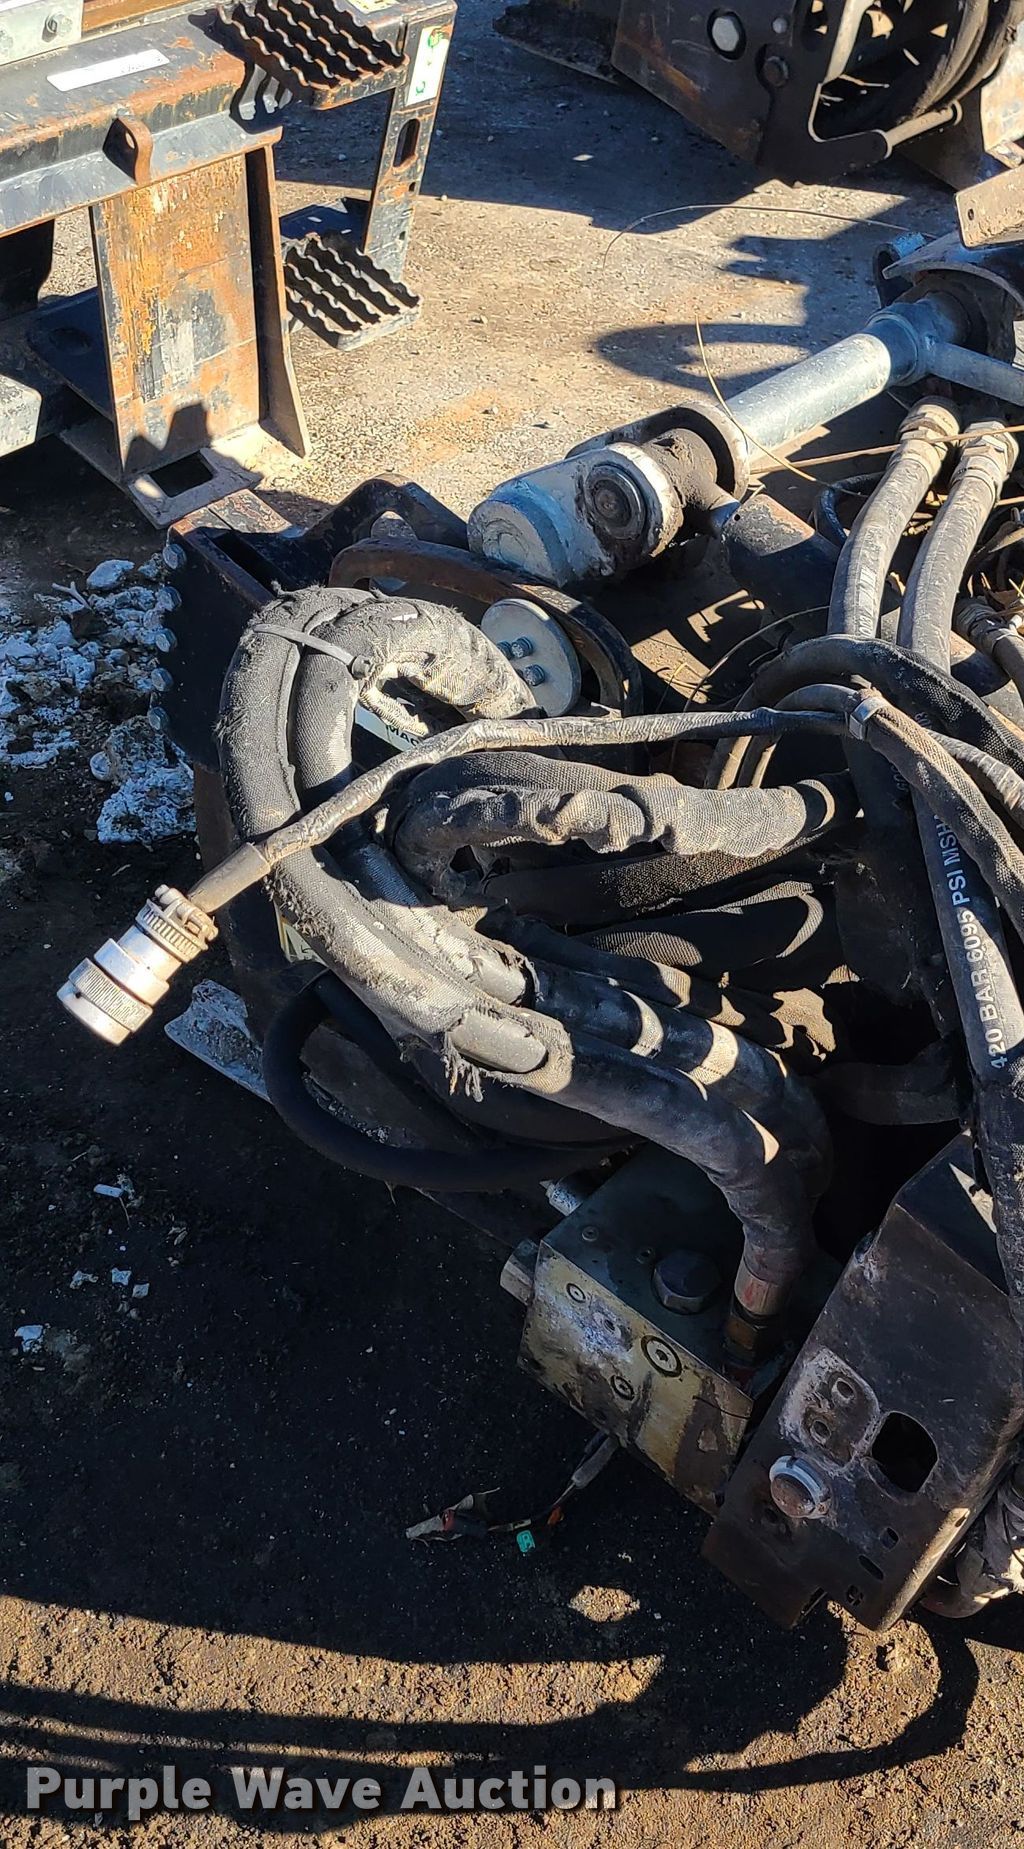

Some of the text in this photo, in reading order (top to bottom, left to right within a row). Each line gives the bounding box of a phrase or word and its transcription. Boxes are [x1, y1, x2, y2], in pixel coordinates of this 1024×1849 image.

[932, 814, 1008, 1070] 420 BAR 6095 PSI MSH
